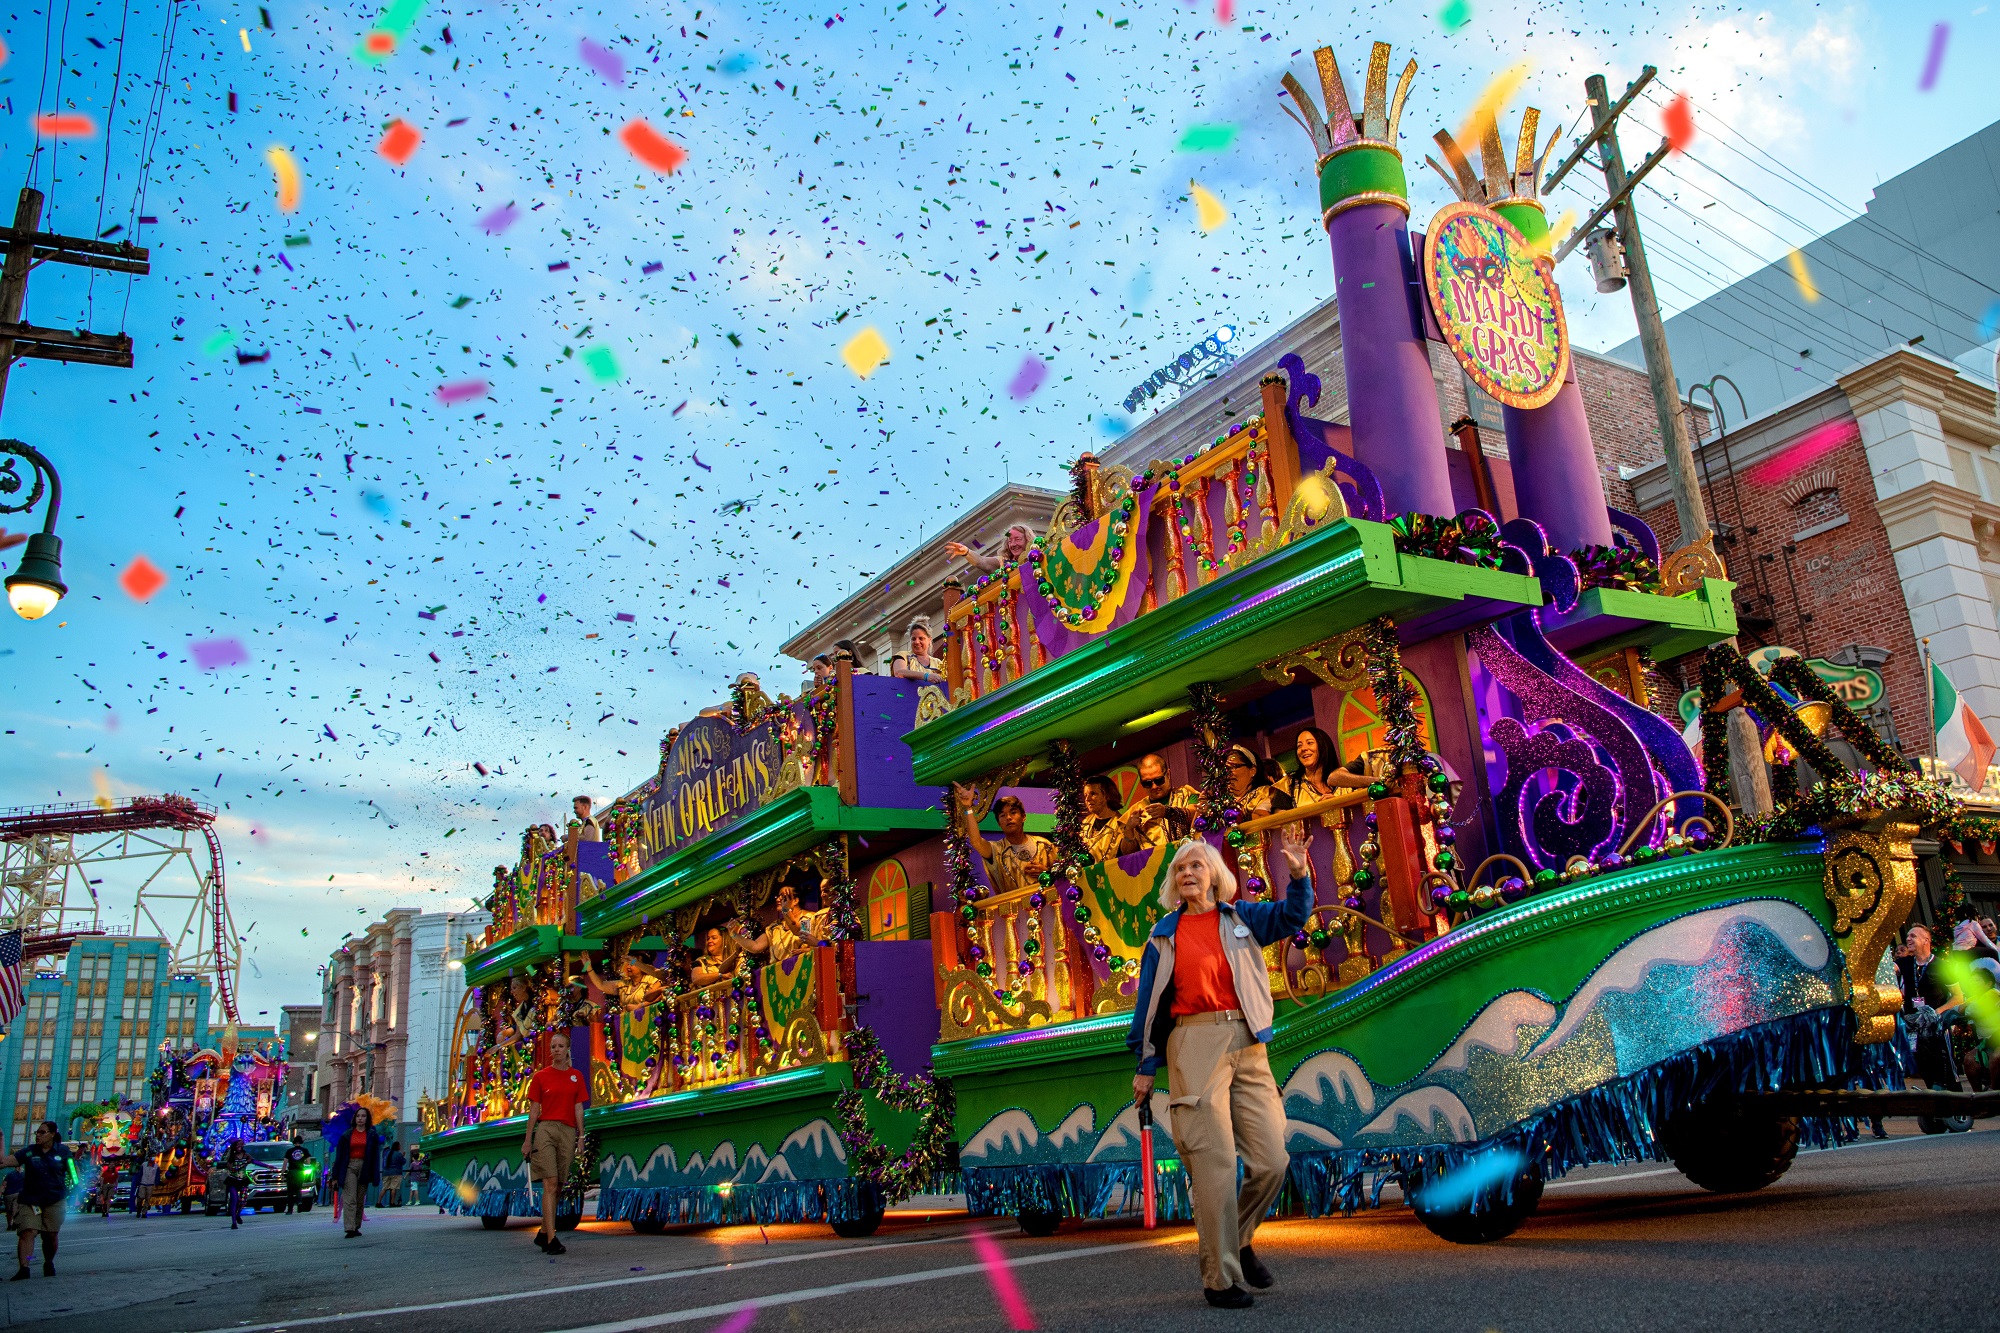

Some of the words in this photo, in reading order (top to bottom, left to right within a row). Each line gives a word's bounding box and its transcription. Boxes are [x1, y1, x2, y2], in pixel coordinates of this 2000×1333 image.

[1449, 279, 1544, 346] MARDI
[1472, 325, 1542, 384] GRAS
[678, 725, 713, 782] MISS
[643, 799, 677, 862] NEW
[679, 738, 771, 837] ORLEANS
